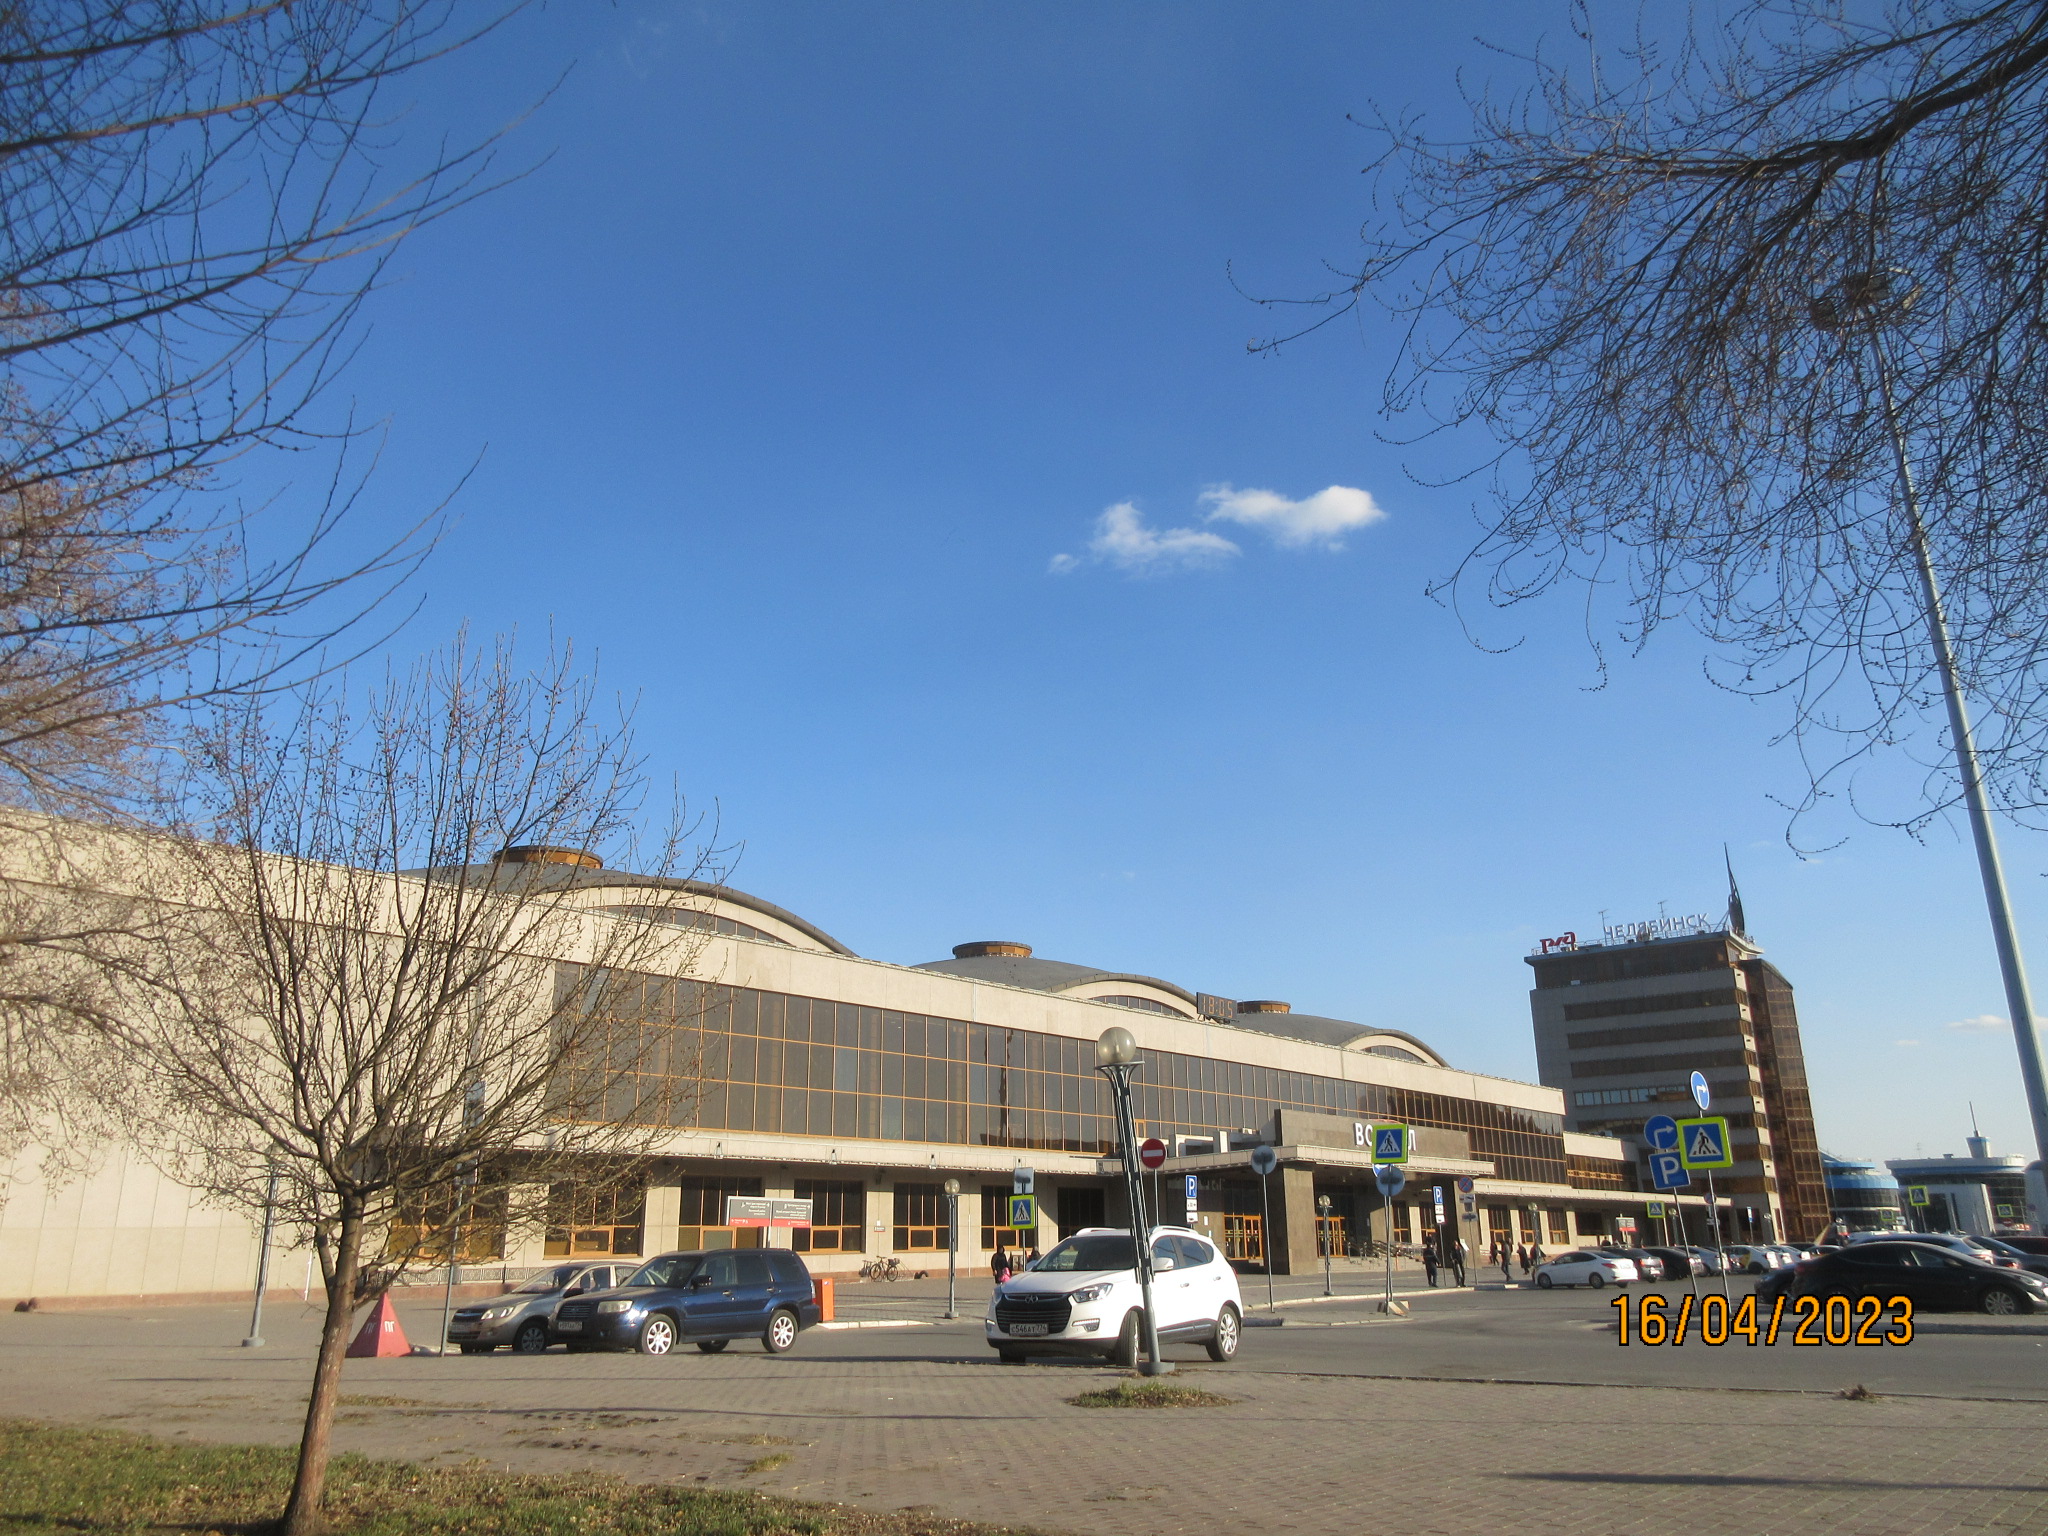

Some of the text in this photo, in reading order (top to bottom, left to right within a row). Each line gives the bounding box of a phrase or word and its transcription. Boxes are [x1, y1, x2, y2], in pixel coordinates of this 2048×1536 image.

[1604, 913, 1710, 938] ЧЕЛЯБИНСК
[1203, 995, 1233, 1018] 18:05
[1354, 1122, 1416, 1151] ВОЛ
[1660, 1157, 1679, 1185] P
[1189, 1177, 1195, 1196] P
[1435, 1188, 1441, 1203] P
[384, 1320, 395, 1333] ПГ
